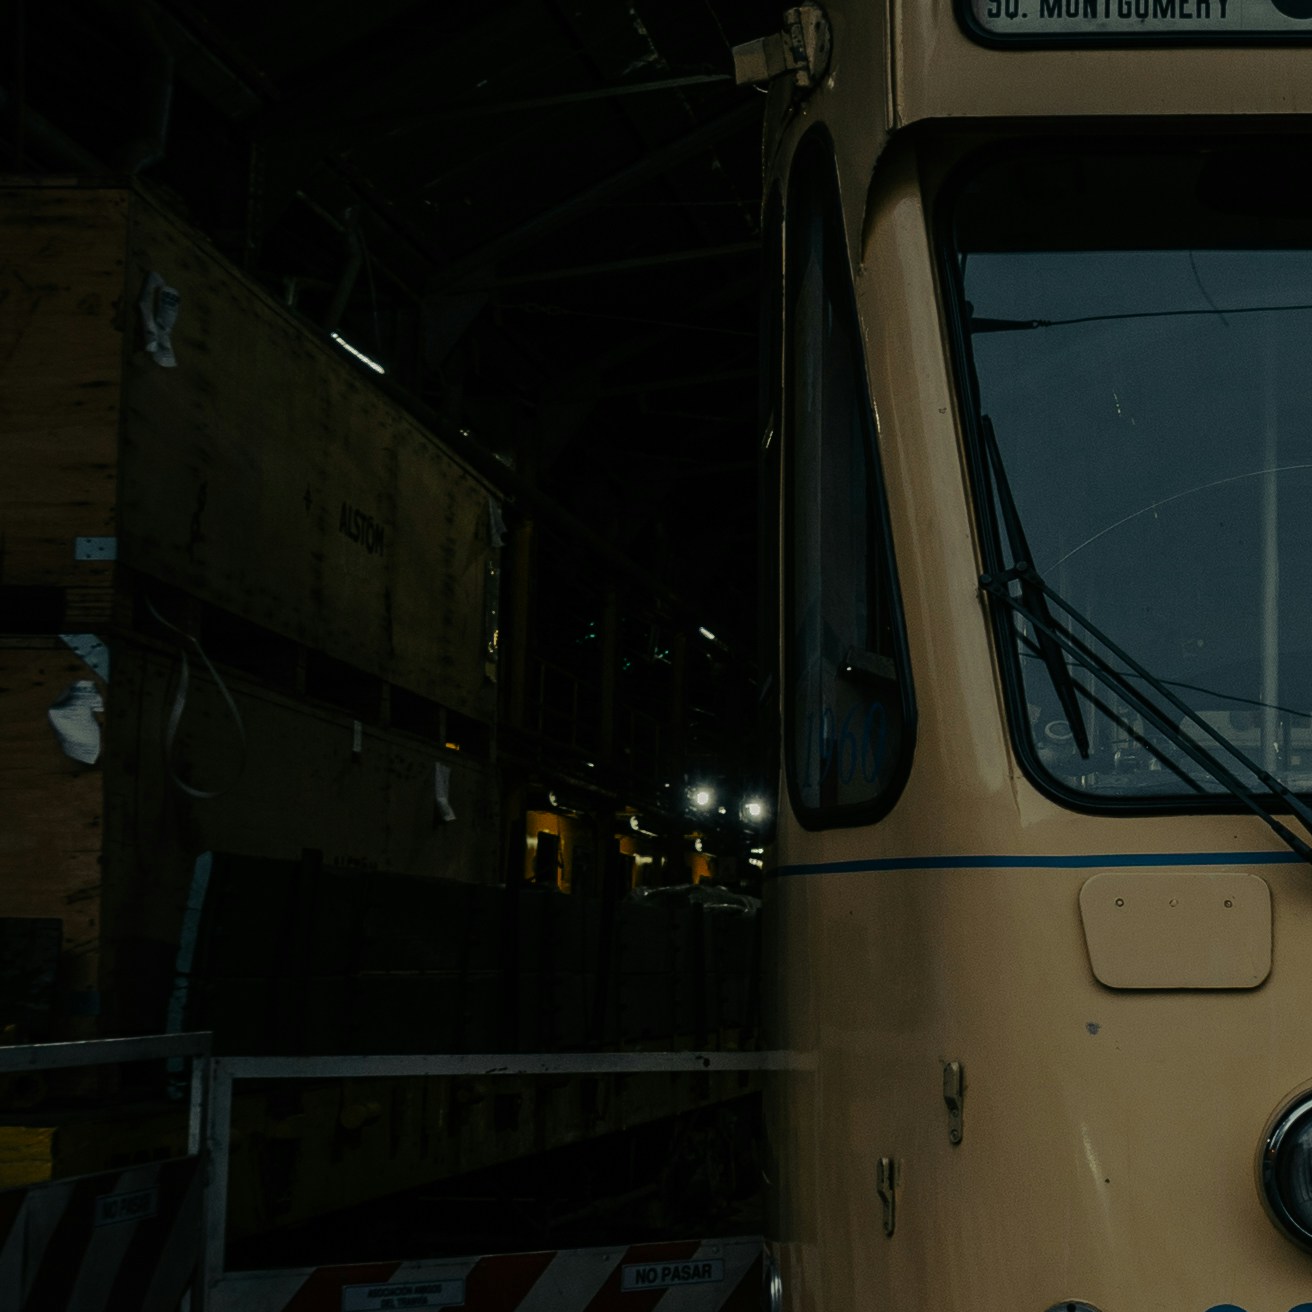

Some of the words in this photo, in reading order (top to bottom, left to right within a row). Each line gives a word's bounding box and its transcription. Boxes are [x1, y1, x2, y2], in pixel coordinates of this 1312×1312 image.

[338, 499, 385, 558] ALSTOM
[802, 701, 888, 788] 1960
[635, 1267, 658, 1285] NO
[661, 1263, 713, 1283] PASAR
